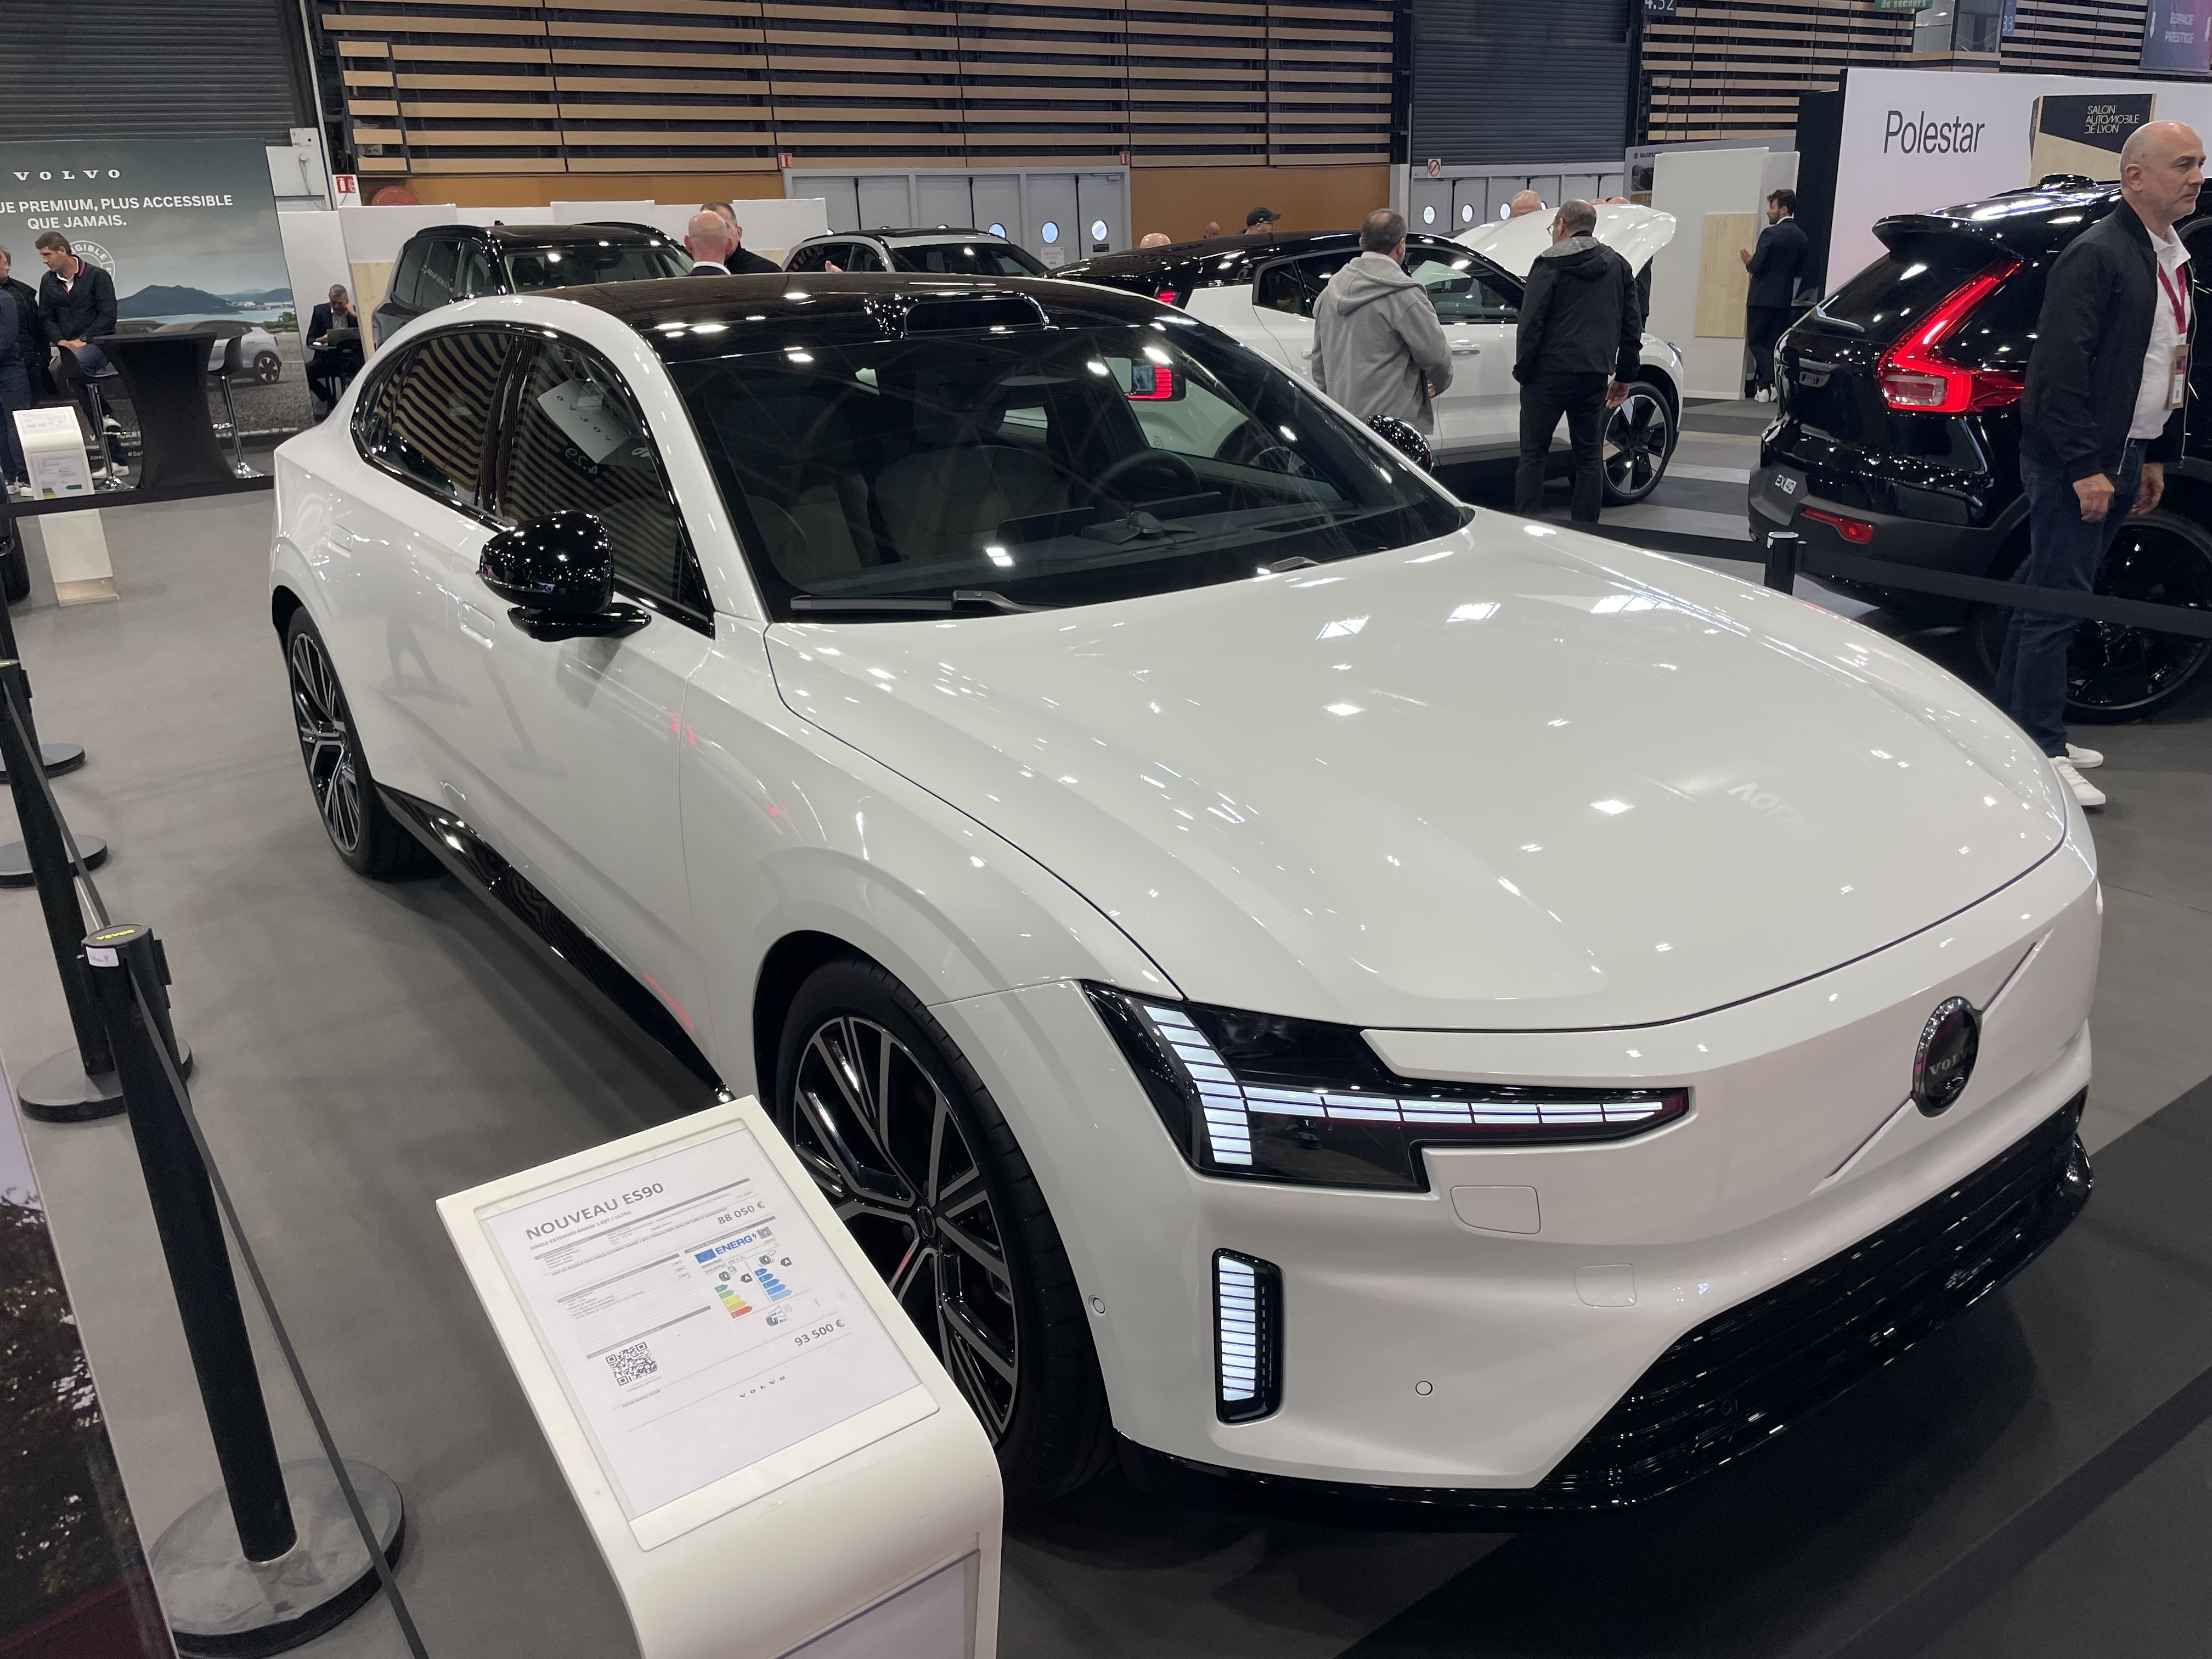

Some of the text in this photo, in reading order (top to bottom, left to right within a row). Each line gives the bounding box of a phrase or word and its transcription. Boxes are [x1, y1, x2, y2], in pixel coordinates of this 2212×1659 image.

[1881, 0, 1891, 8] de
[2170, 13, 2194, 25] ESPACE
[2164, 31, 2194, 44] PRESTIGE
[2087, 105, 2116, 115] SALON
[2085, 114, 2140, 124] AUTOMOBILE
[1884, 110, 1985, 154] Polestar
[2084, 124, 2119, 134] DE LYON
[13, 168, 121, 181] VOLVO
[19, 199, 98, 213] PREMIUM,
[101, 196, 140, 210] PLUS
[143, 194, 233, 208] ACCESSIBLE
[27, 215, 127, 230] QUE JAMAIS.
[95, 928, 136, 940] VEVOR
[525, 1198, 619, 1240] NOUVEAU
[622, 1182, 664, 1205] ES90
[717, 1201, 766, 1224] 88 050 €
[714, 1235, 753, 1255] ENERG
[794, 1319, 845, 1347] 93 500 €
[738, 1375, 786, 1398] VOLVO
